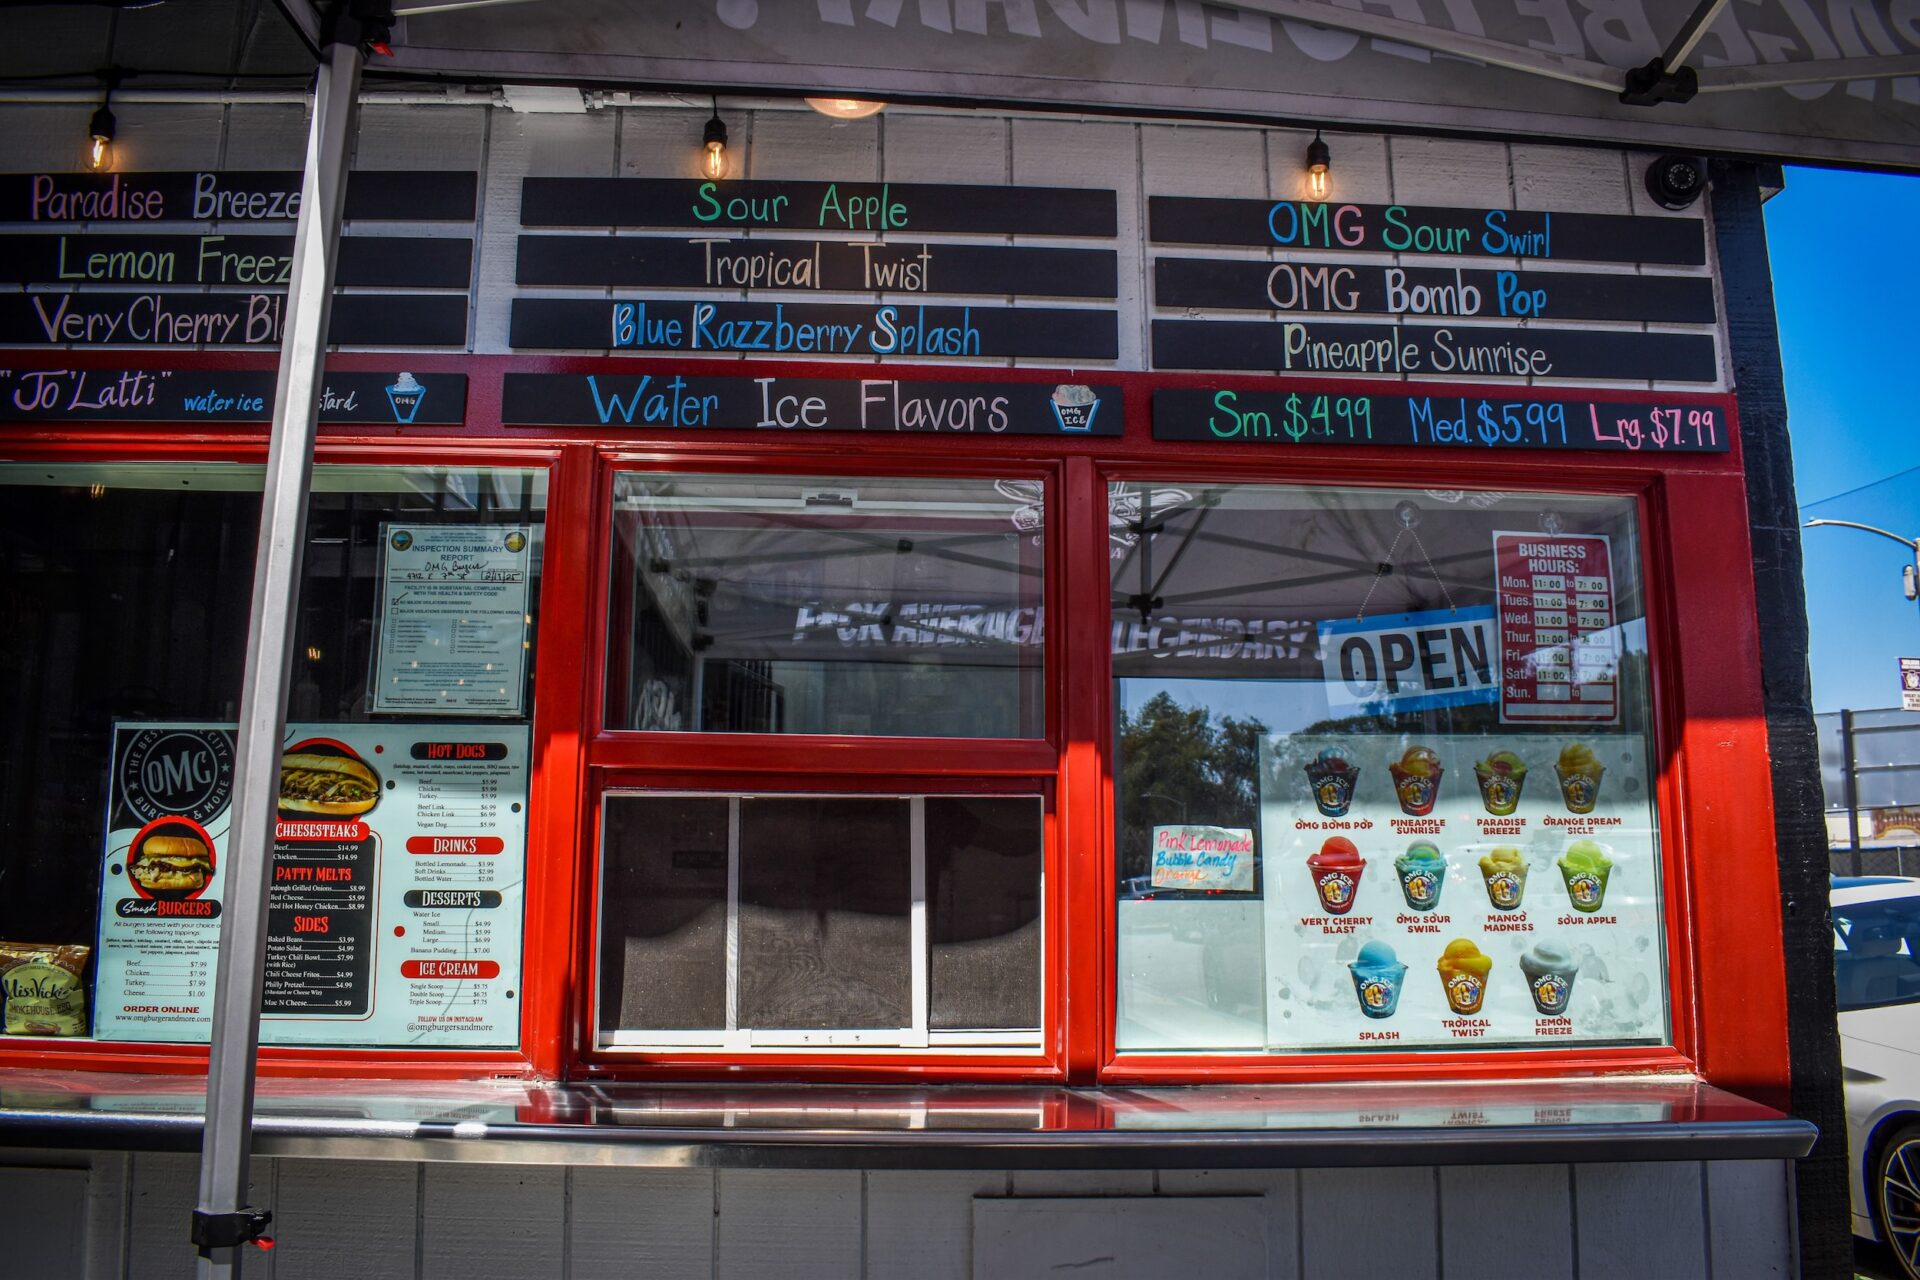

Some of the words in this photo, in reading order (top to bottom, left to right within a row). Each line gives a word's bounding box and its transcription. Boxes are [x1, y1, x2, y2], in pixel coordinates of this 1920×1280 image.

[33, 174, 163, 220] Paradise
[193, 173, 301, 219] Breeze
[693, 182, 788, 222] Sour
[819, 184, 908, 230] Apple
[1268, 202, 1365, 247] OMG
[1381, 205, 1470, 254] Sour
[1481, 210, 1551, 258] Swirl
[59, 237, 174, 281] Lemon
[199, 236, 293, 284] Freez
[689, 239, 821, 290] Tropical
[848, 242, 933, 292] Twist
[1266, 263, 1359, 311] OMG
[1385, 267, 1481, 316] Bomb
[1496, 271, 1547, 317] Pop
[33, 295, 124, 342] Very
[128, 295, 240, 343] Cherry
[613, 303, 682, 348] Blue
[692, 304, 862, 353] Razzberry
[870, 306, 981, 356] Splash
[1284, 323, 1420, 374] Pineapple
[1431, 329, 1553, 376] Sunrise
[184, 389, 234, 412] water
[236, 393, 264, 412] ice
[319, 387, 358, 411] tard
[587, 375, 718, 427] Water
[755, 377, 827, 428] Ice
[860, 379, 1010, 432] Flavors
[1060, 407, 1083, 417] OMG
[1064, 415, 1087, 425] ICE
[1209, 390, 1278, 438] Sm.
[1284, 393, 1374, 442] $4.99
[1409, 397, 1473, 443] Med.
[1478, 400, 1567, 447] $5.99
[1590, 403, 1646, 450] Lrg.
[1651, 407, 1717, 448] $7.99
[1518, 543, 1586, 559] BUSINESS
[1529, 559, 1580, 573] HOURS:
[1503, 576, 1530, 588] Mon.
[1566, 579, 1575, 588] to
[1504, 595, 1532, 606] Tues.
[1568, 597, 1576, 606] to
[1504, 612, 1531, 625] Wed.
[1569, 615, 1577, 624] to
[1505, 631, 1533, 643] Thur.
[1340, 625, 1492, 698] OPEN
[1506, 649, 1524, 661] Fri.
[1506, 668, 1528, 679] Sat.
[1506, 687, 1531, 698] Sun.
[1571, 688, 1580, 697] to
[428, 744, 452, 758] HOT
[456, 744, 486, 758] DOGS
[147, 750, 211, 796] OMG
[204, 780, 229, 812] MORE
[1295, 818, 1319, 829] OMG
[1322, 818, 1351, 829] BOMB
[1354, 818, 1373, 829] POP
[1391, 819, 1446, 827] PINEAPPLE
[1477, 818, 1526, 826] PARADISE
[1543, 815, 1584, 825] ORANGE
[275, 822, 358, 837] CHEESESTEAKS
[1397, 826, 1440, 834] SUNRISE
[1483, 827, 1521, 835] BREEZE
[1567, 826, 1594, 834] SICLE
[433, 838, 477, 853] DRINKS
[1158, 831, 1188, 850] Pink
[1156, 850, 1194, 867] Bubble
[1196, 851, 1237, 877] Candy
[276, 866, 313, 881] PATTY
[316, 867, 352, 881] MELTS
[422, 891, 481, 906] DESSERTS
[122, 901, 157, 914] Smash
[158, 901, 211, 916] BURGERS
[1332, 917, 1373, 925] CHERRY
[1397, 913, 1420, 924] OMG
[1423, 913, 1450, 924] SOUR
[1487, 912, 1527, 922] MANGO
[1558, 914, 1584, 925] SOUR
[293, 916, 328, 932] SIDES
[1323, 926, 1355, 934] BLAST
[1408, 925, 1440, 933] SWIRL
[419, 962, 435, 976] ICE
[439, 962, 478, 976] CREAM
[1448, 975, 1465, 988] OMG
[1468, 975, 1482, 988] ICE
[1534, 975, 1552, 988] OMG
[1554, 975, 1568, 988] ICE
[123, 1005, 159, 1013] ORDER
[1442, 1018, 1491, 1028] TROPICAL
[1535, 1016, 1572, 1027] LEMON
[1359, 1032, 1400, 1040] SPLASH
[1451, 1029, 1485, 1037] TWIST
[1535, 1028, 1572, 1036] FREEZE
